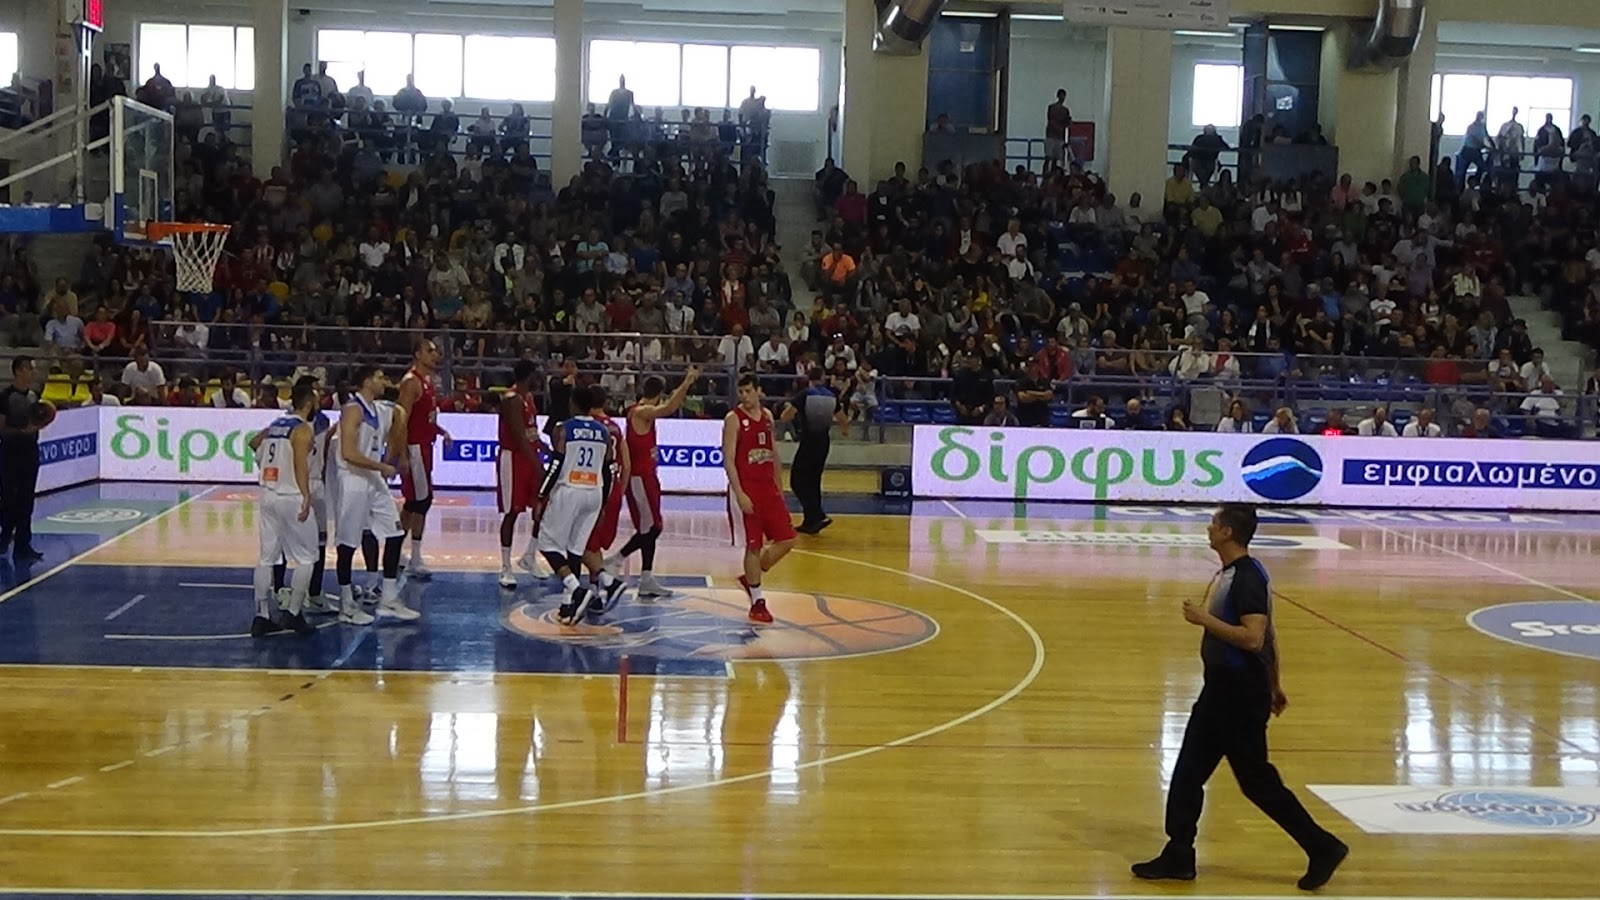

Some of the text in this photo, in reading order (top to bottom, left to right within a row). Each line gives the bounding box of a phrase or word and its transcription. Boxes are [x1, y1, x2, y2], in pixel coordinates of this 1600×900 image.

[268, 442, 276, 463] 9
[577, 447, 594, 468] 32
[660, 445, 723, 468] νερό
[1364, 460, 1597, 488] εμφιαλωμένο
